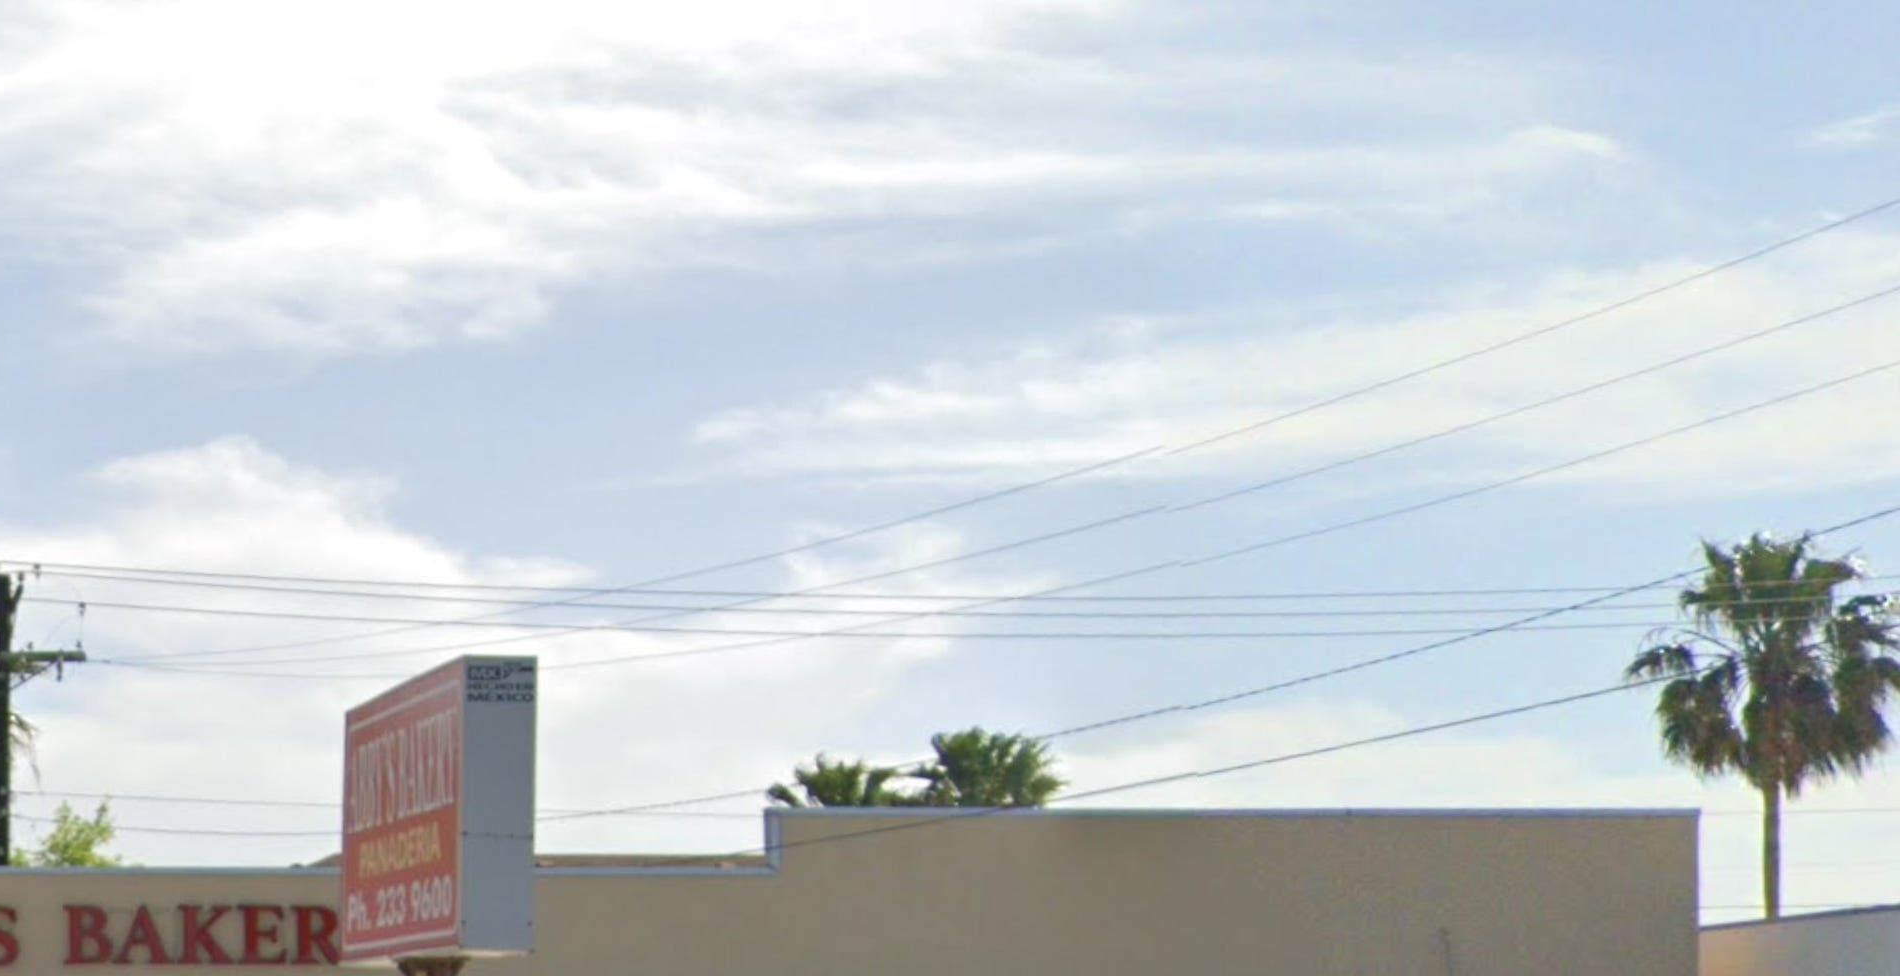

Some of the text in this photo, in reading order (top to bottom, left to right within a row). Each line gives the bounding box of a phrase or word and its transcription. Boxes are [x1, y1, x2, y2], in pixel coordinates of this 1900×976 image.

[348, 704, 458, 834] ABBY'S BAKERY
[348, 874, 453, 932] Ph. 233 9600
[63, 904, 341, 967] BAKER
